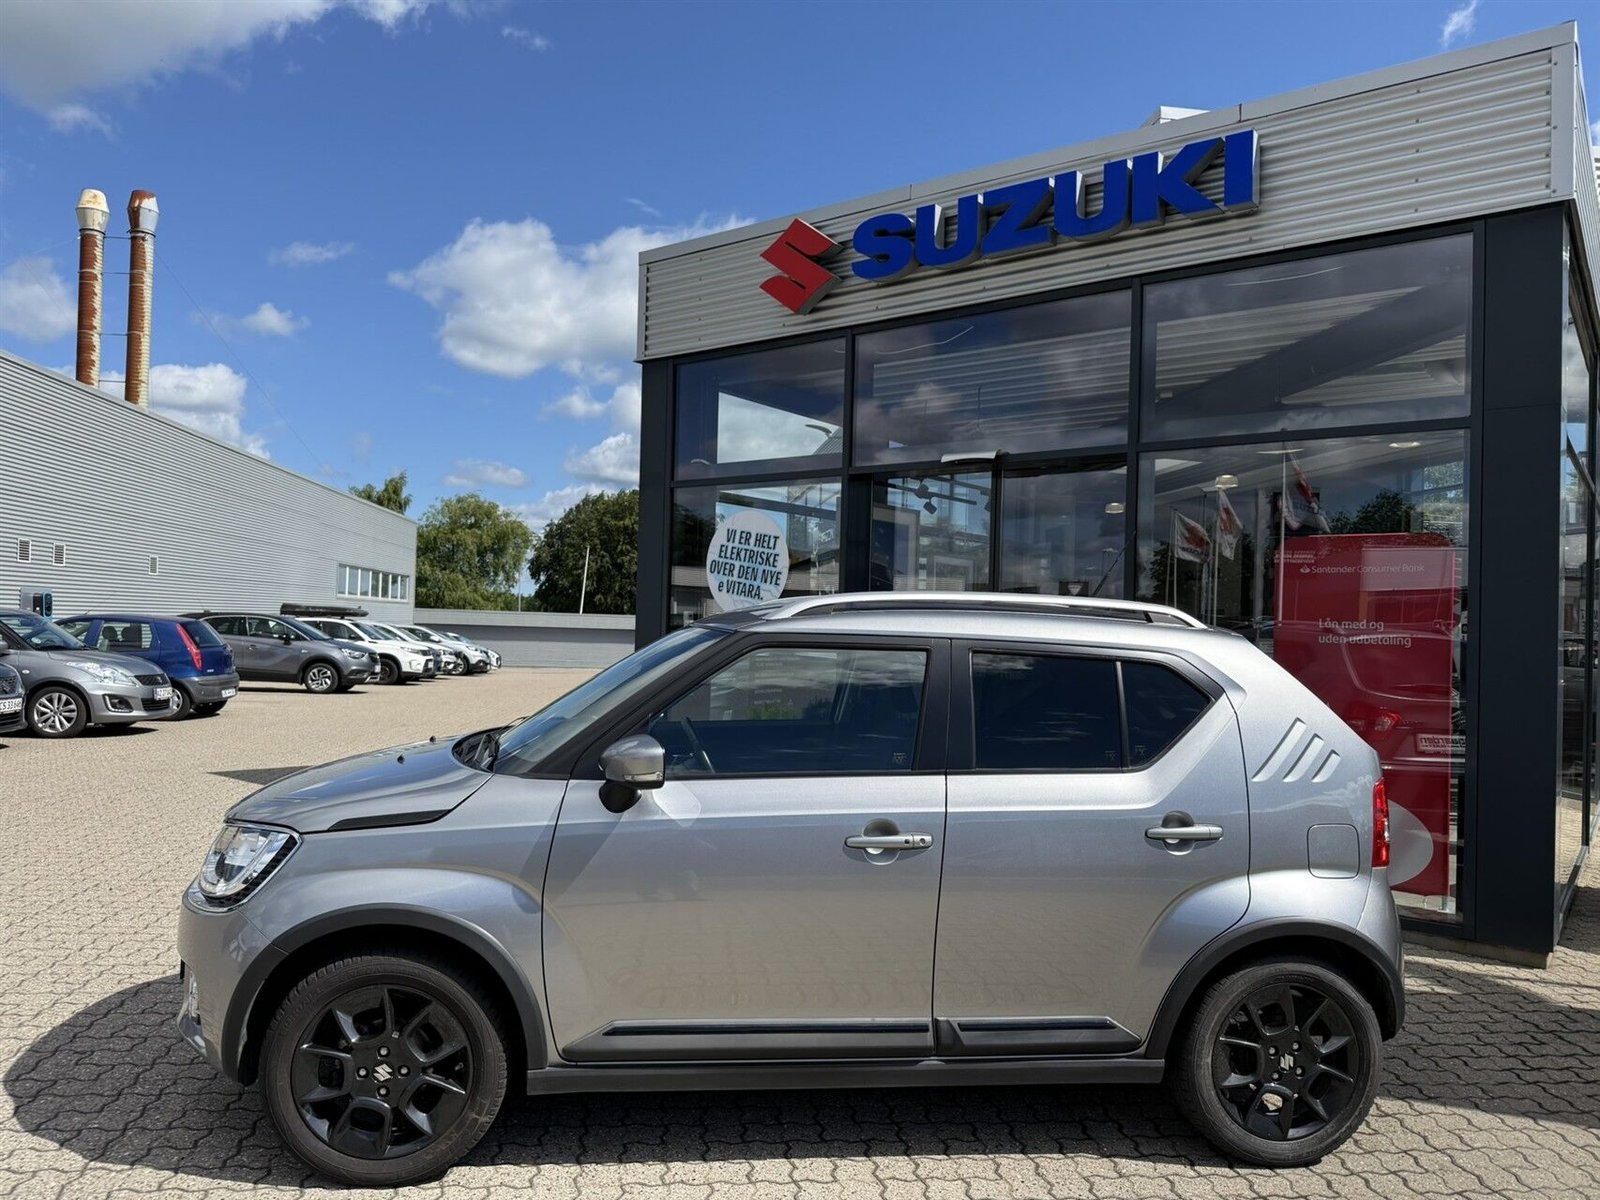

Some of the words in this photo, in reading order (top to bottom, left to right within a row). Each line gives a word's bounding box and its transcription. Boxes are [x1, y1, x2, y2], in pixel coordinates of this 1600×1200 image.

[852, 129, 1260, 282] SUZUKI
[726, 528, 736, 543] VI
[739, 530, 751, 545] ER
[754, 533, 780, 550] HELT
[718, 544, 780, 568] ELEKTRISKE
[709, 560, 735, 578] OVER
[738, 564, 758, 582] DEN
[760, 569, 783, 586] NYE
[1311, 565, 1356, 575] Santander
[1357, 564, 1401, 574] Consumer
[1402, 563, 1425, 573] Bank
[718, 581, 724, 593] e
[726, 580, 764, 600] VITARA.
[1318, 617, 1339, 629] Lån
[1341, 618, 1367, 629] med
[1369, 620, 1384, 631] og
[1318, 634, 1347, 644] uden
[1349, 634, 1412, 648] udbetaling
